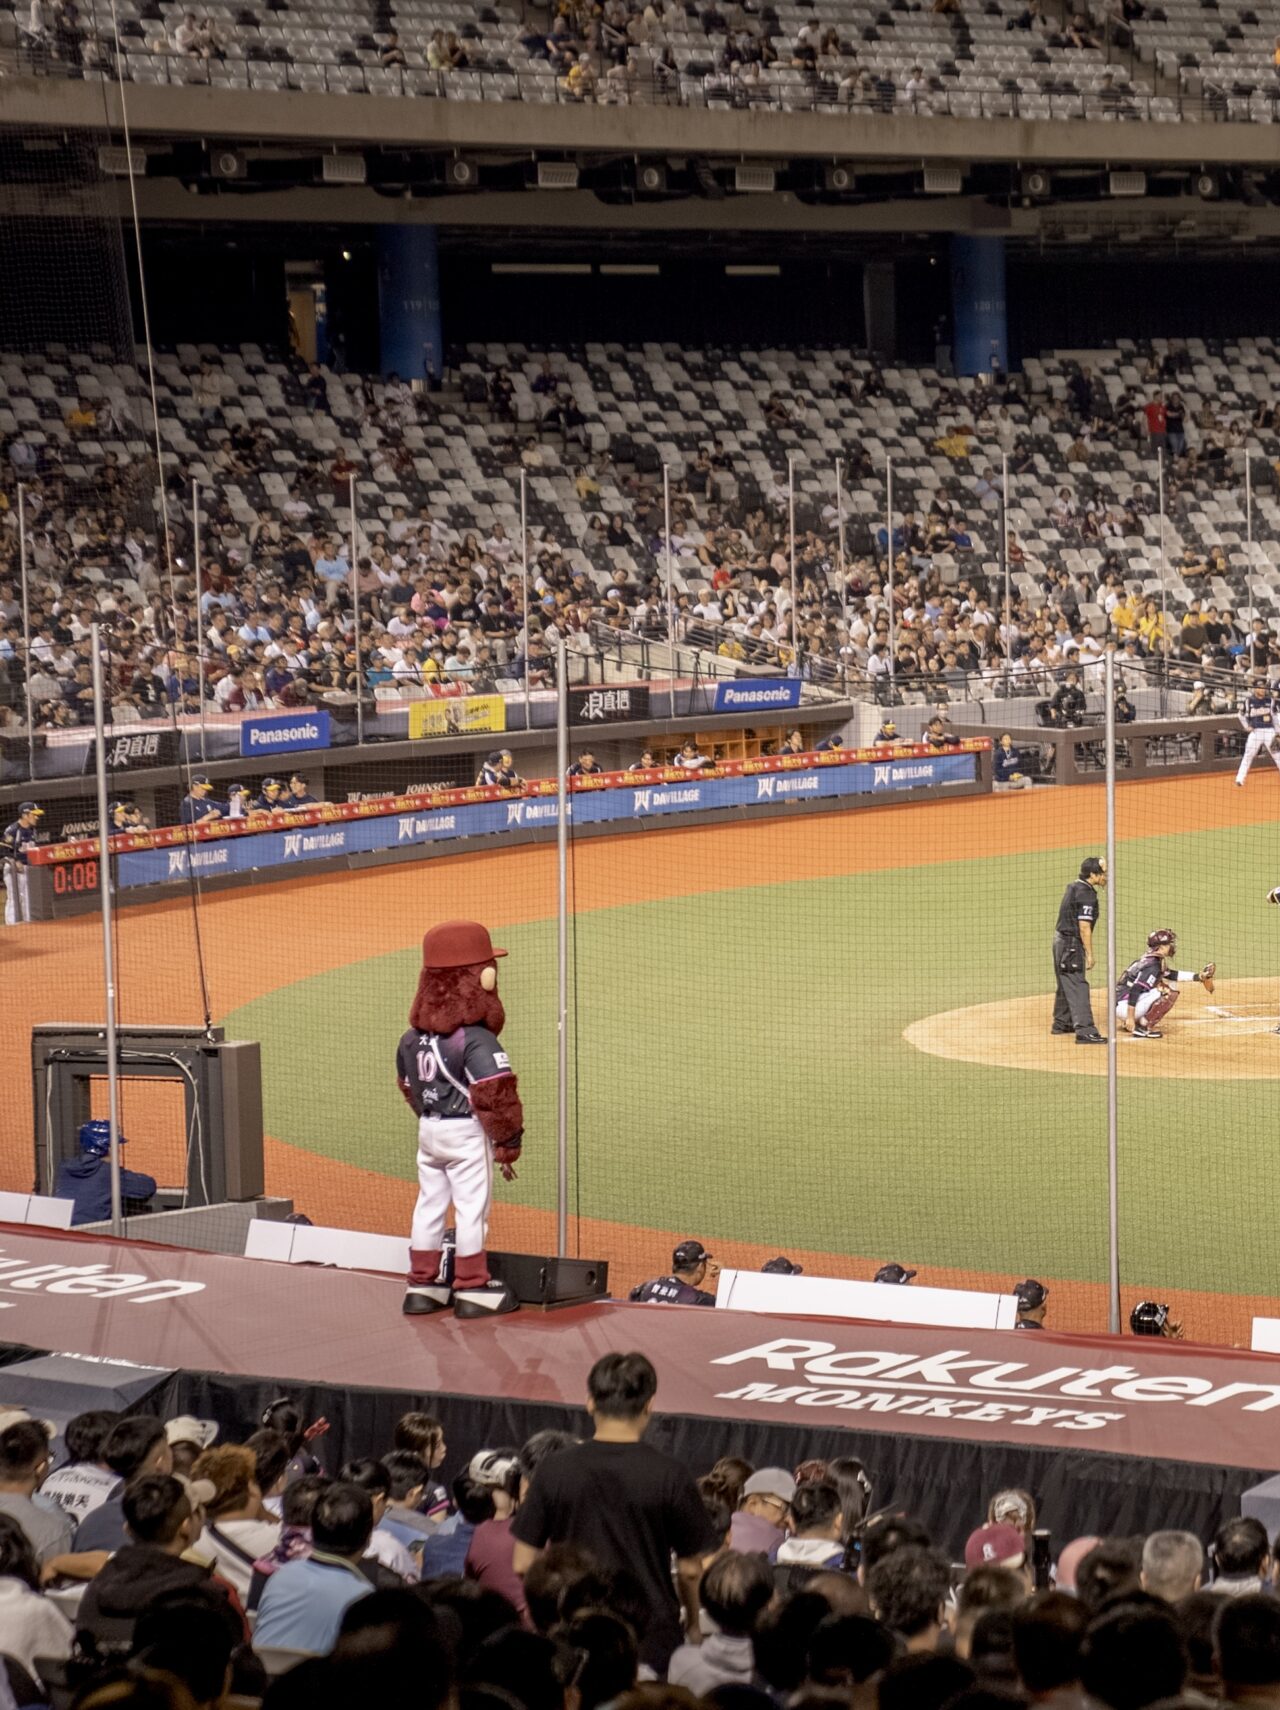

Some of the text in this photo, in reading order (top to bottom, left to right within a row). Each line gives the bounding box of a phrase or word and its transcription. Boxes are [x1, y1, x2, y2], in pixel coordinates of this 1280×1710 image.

[724, 686, 791, 704] Panasonic
[250, 723, 319, 745] Panasonic
[776, 776, 818, 792] DAVILLAGE
[652, 789, 700, 806] DAVILLAGE
[526, 802, 571, 819] DAVILLAE
[61, 820, 100, 838] JOHNSO
[415, 815, 455, 833] DAVILLAGE
[303, 831, 344, 851] DAVILLAGE
[54, 861, 97, 894] 0:08
[416, 1051, 437, 1082] 10
[714, 1382, 1126, 1431] MONKEYS
